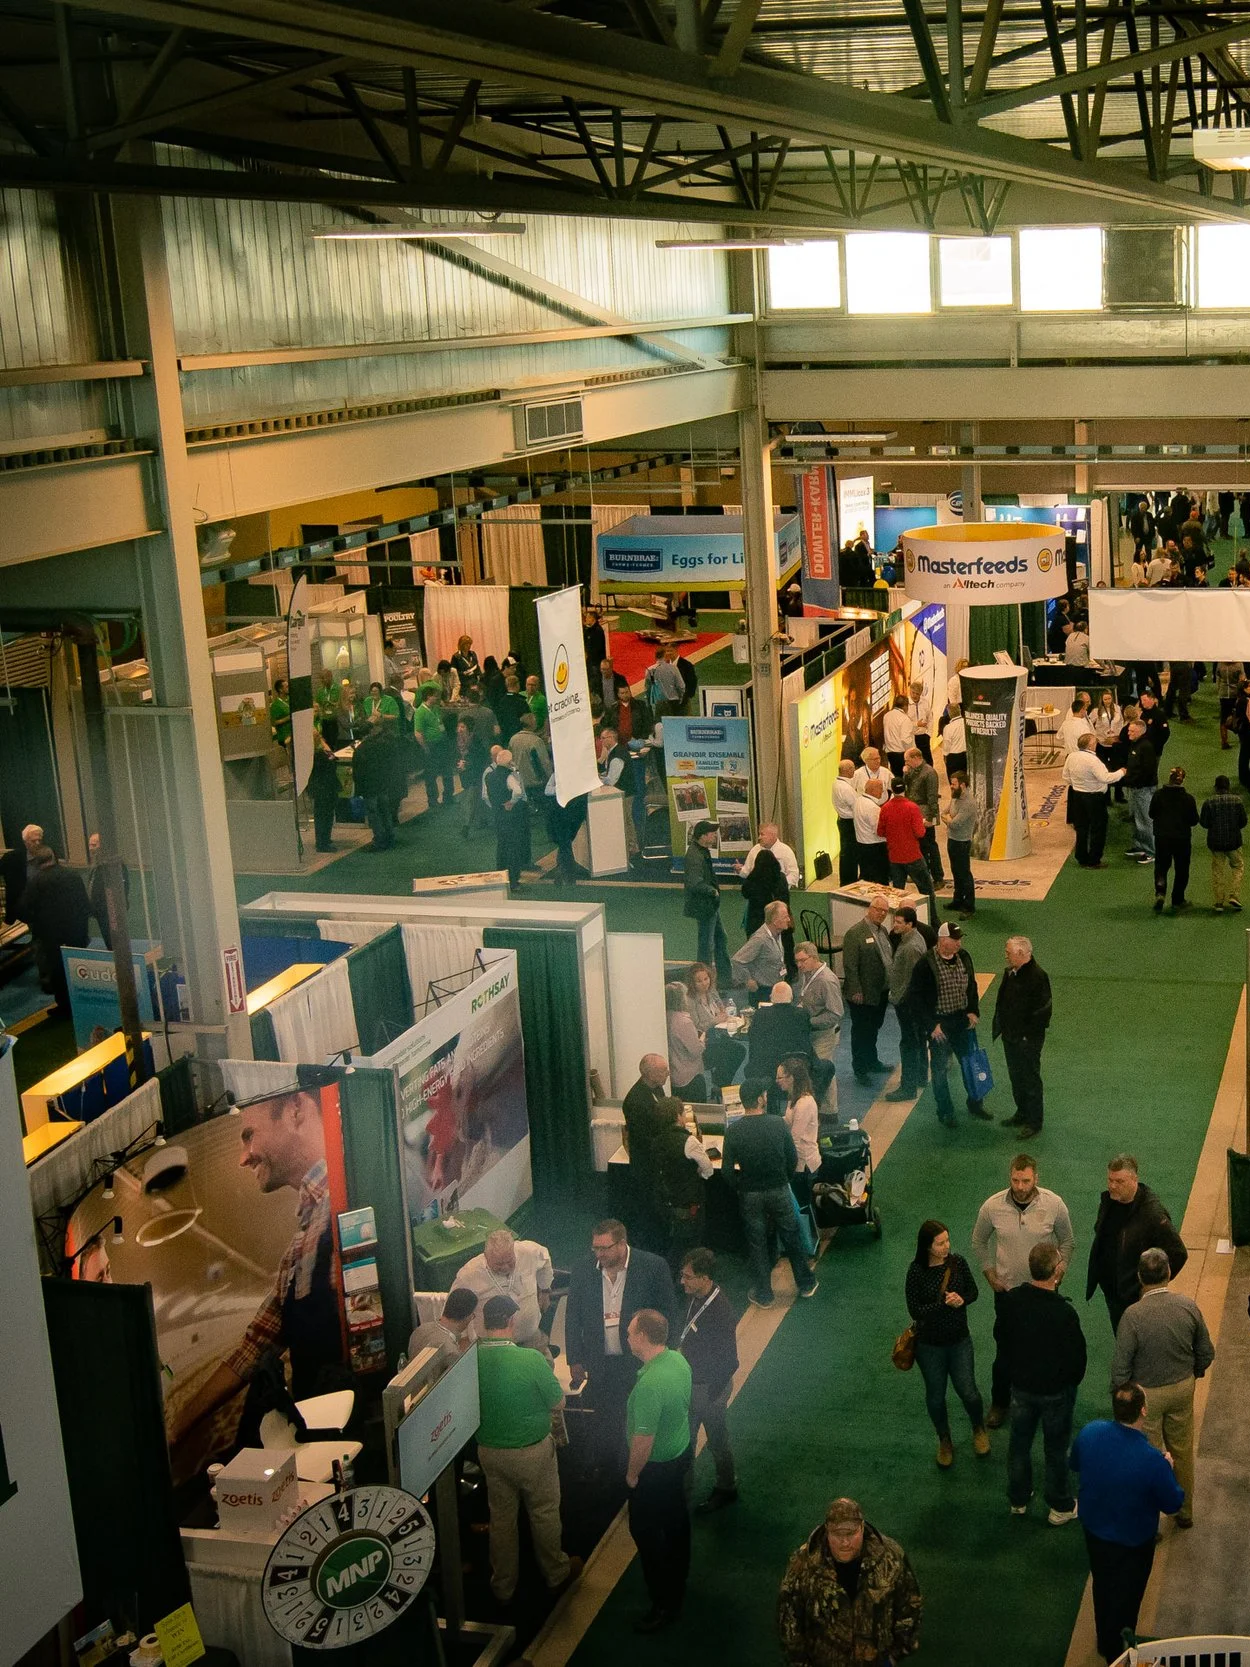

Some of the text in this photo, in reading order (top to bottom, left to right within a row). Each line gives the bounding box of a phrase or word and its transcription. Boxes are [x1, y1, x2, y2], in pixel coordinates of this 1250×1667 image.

[672, 553, 703, 568] Eggs
[708, 552, 728, 565] for
[918, 555, 1028, 575] Masterfeeds
[952, 577, 995, 589] Alltech
[996, 581, 1025, 590] company
[383, 613, 415, 623] POULTRY
[471, 972, 510, 1014] ROTHSAY
[272, 1471, 295, 1502] zoetis
[222, 1493, 263, 1507] zoetis
[358, 1498, 370, 1518] 3
[338, 1503, 350, 1522] 4
[376, 1501, 388, 1518] 1
[388, 1507, 406, 1525] 2
[319, 1517, 331, 1532] 1
[399, 1520, 419, 1535] 5
[301, 1530, 318, 1546] 2
[403, 1537, 422, 1548] 1
[403, 1556, 422, 1566] 3
[277, 1568, 299, 1580] 4
[326, 1550, 383, 1598] MNP
[396, 1574, 415, 1584] 2
[277, 1586, 298, 1600] 3
[384, 1590, 400, 1603] 4
[285, 1601, 303, 1616] 1
[370, 1603, 384, 1619] 2
[295, 1610, 313, 1629] 2
[310, 1617, 328, 1638] 5
[336, 1617, 343, 1636] 1
[354, 1612, 364, 1631] 3
